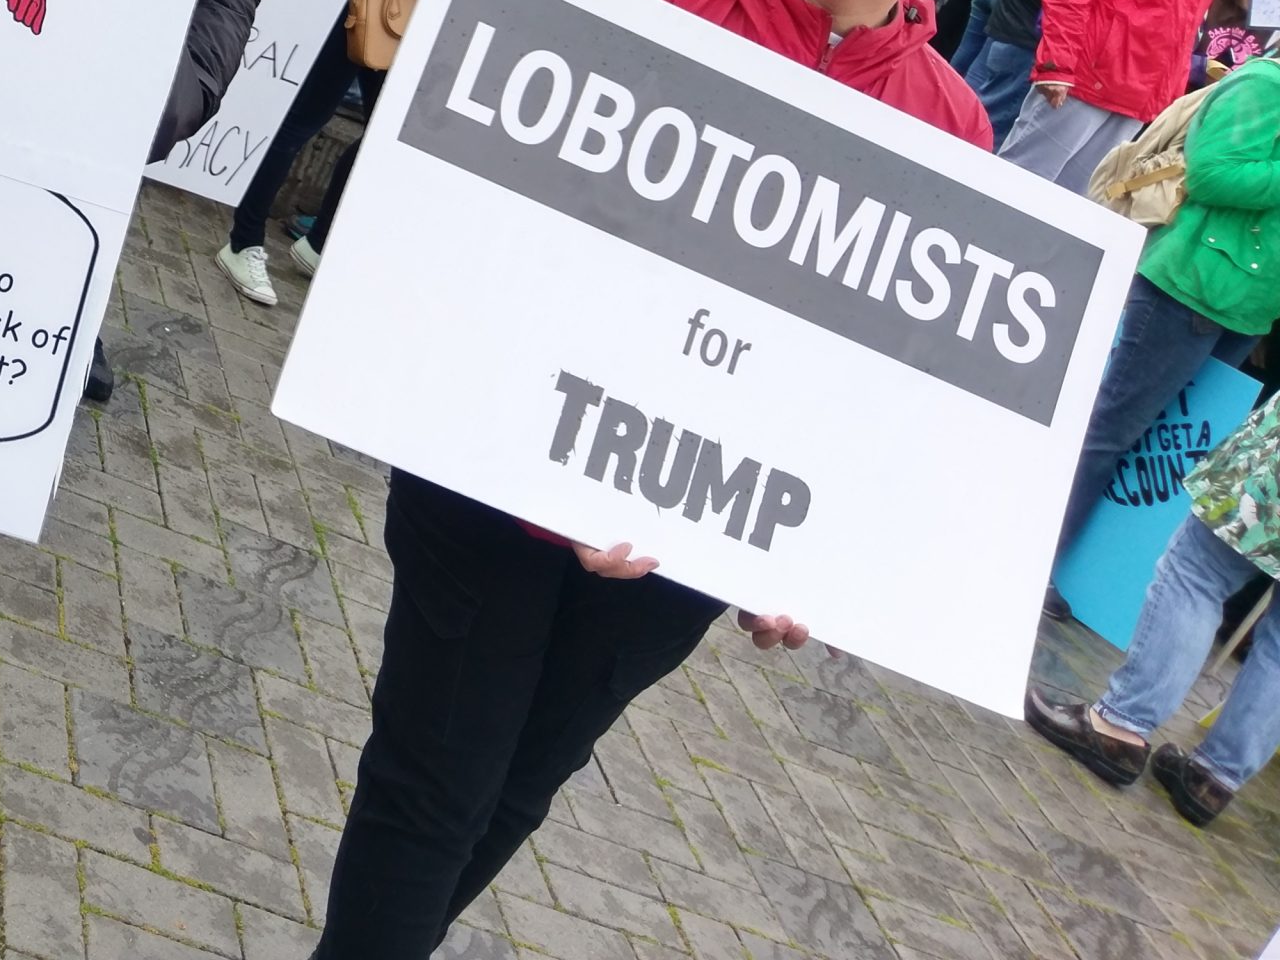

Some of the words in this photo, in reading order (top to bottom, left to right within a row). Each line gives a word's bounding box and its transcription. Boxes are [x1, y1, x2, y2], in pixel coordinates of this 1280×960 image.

[446, 20, 1057, 364] LOBOTOMISTS
[31, 326, 71, 355] of
[682, 308, 753, 375] for
[548, 367, 811, 552] TRUMP
[1157, 422, 1193, 452] GET
[1196, 420, 1211, 448] A
